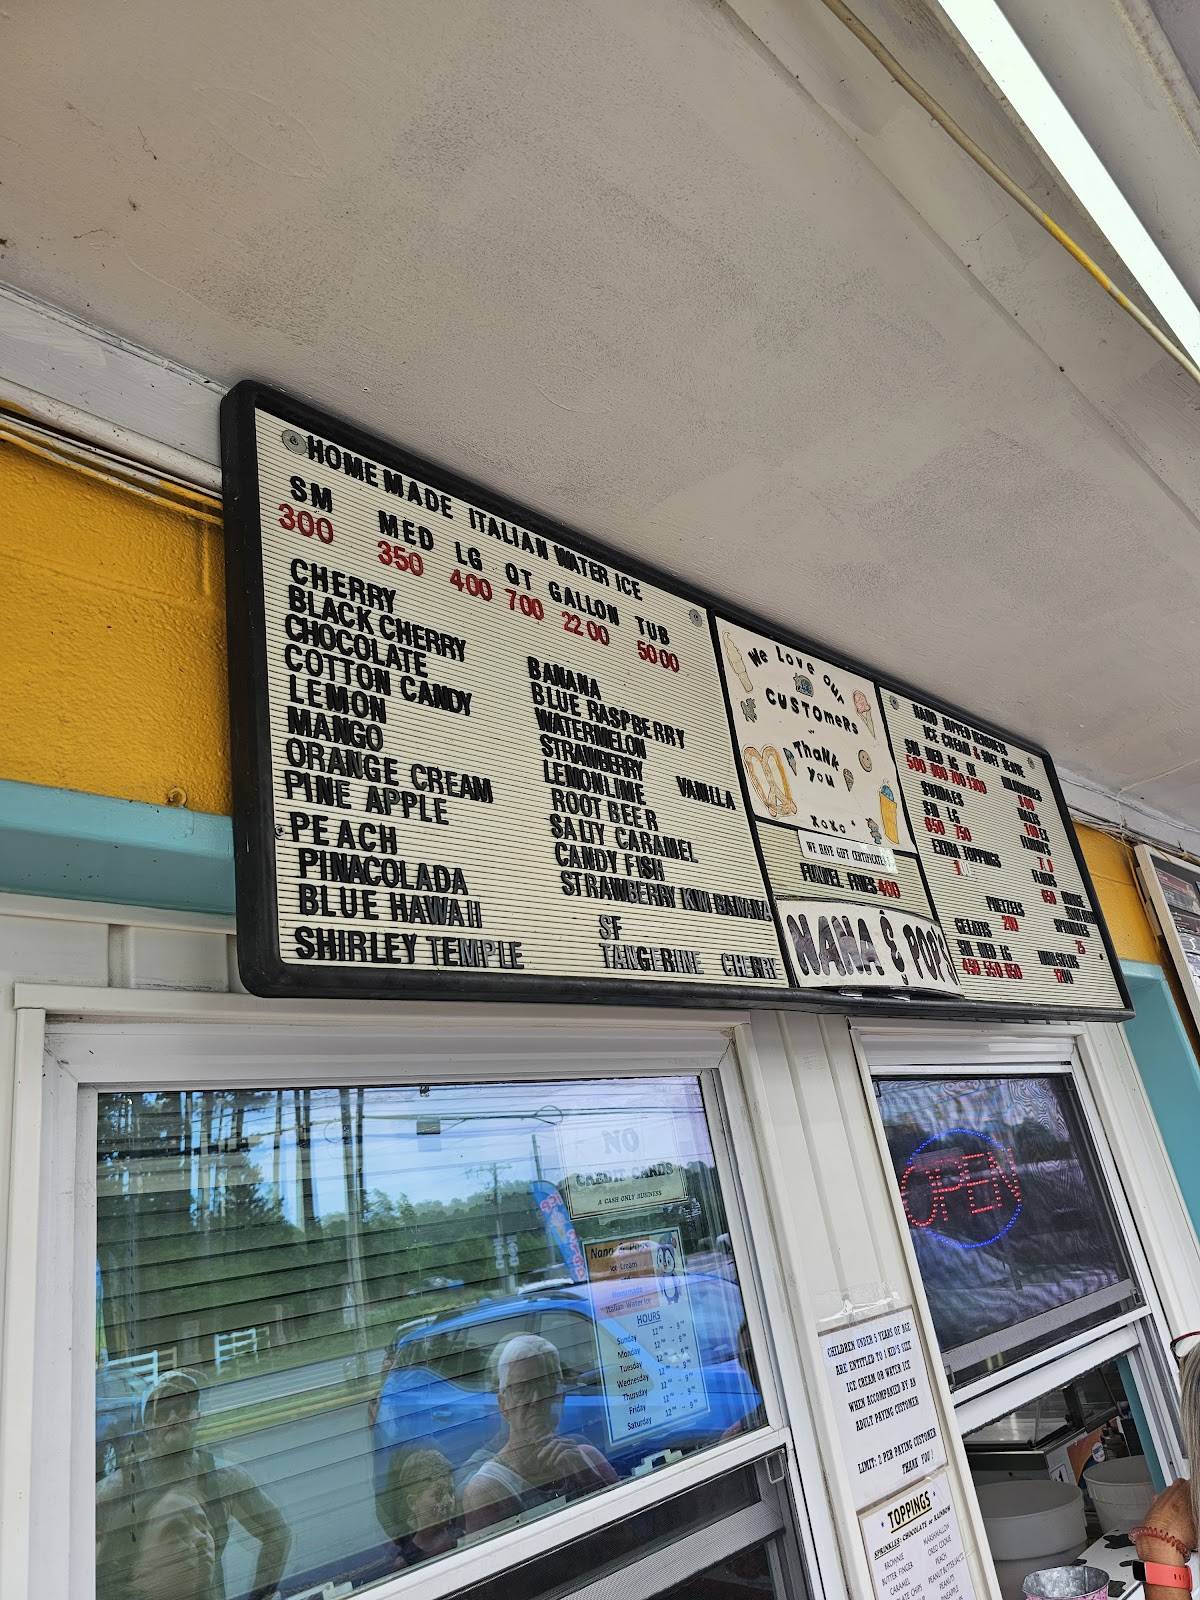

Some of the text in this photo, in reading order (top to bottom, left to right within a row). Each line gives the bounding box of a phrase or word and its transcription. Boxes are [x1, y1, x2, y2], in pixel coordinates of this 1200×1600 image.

[307, 436, 642, 601] HOME MADE ITALIAN WATER ICE
[290, 475, 669, 645] SM MED LG QT GALLON TUB
[278, 504, 333, 544] 300
[377, 541, 423, 576] 350
[450, 569, 492, 601] 400
[504, 588, 544, 621] 700
[637, 640, 679, 673] 5000
[290, 559, 396, 614] CHERRY
[288, 585, 466, 662] BLACK CHERRY
[285, 614, 428, 678] CHOCOLATE
[284, 644, 472, 717] COTTON CANDY
[528, 656, 600, 699] BANANA
[748, 648, 768, 667] We
[823, 674, 844, 704] our
[289, 674, 386, 724] LEMON
[531, 682, 684, 749] BLUE RASPBERRY
[287, 706, 383, 751] MANGO
[535, 707, 646, 759] WATERMELON
[923, 725, 939, 742] ICE
[942, 733, 971, 755] CREAM
[972, 746, 980, 759] &
[286, 738, 493, 804] ORANGE CREAM
[540, 735, 642, 781] STRAWBERRY
[904, 738, 921, 756] SM
[925, 747, 943, 764] MED
[948, 755, 959, 770] LG
[906, 754, 926, 772] 500
[284, 770, 449, 825] PINE APPLE
[551, 788, 658, 831] ROOT BEER
[676, 776, 736, 810] VANILLA
[921, 781, 963, 806] SUNDAES
[923, 800, 960, 823] SM LG
[290, 812, 397, 855] PEACH
[550, 814, 698, 863] SALTY CARAMEL
[806, 841, 816, 852] WE
[818, 844, 834, 857] HAVE
[932, 838, 960, 857] EXTRA
[554, 842, 665, 881] CANDY FISH
[299, 884, 482, 928] BLUE HAWAII
[560, 870, 773, 921] STRAWBERRY KIWI BANANA
[987, 897, 1024, 915] PRETZELS
[599, 914, 622, 940] SF
[787, 914, 884, 976] NANA
[295, 926, 524, 969] SHIRLEY TEMPLE
[599, 943, 777, 979] TANGERINE CHERRY
[957, 940, 1012, 960] SM MED LG
[621, 1194, 635, 1203] ONLY
[637, 1311, 661, 1325] HOURS
[617, 1335, 637, 1345] Sunday
[618, 1348, 640, 1359] Monday
[827, 1341, 855, 1357] CHILDREN
[856, 1335, 872, 1348] UNDER
[879, 1328, 893, 1340] YEARS
[617, 1374, 649, 1388] Wednesday
[620, 1362, 642, 1373] Tuesday
[836, 1363, 847, 1375] ARE
[849, 1354, 874, 1370] ENTITLED
[875, 1351, 882, 1361] TO
[846, 1360, 910, 1392] ICE CREAM OR WATER ICE
[623, 1388, 648, 1401] Thursday
[629, 1404, 646, 1415] Friday
[849, 1377, 916, 1412] WHEN BY AN
[628, 1416, 651, 1430] Saturday
[855, 1397, 919, 1430] ADULT PAYING CUSTOMER
[878, 1455, 881, 1464] 2
[883, 1450, 893, 1462] PER
[894, 1440, 912, 1456] PAYING
[913, 1428, 936, 1446] CUSTOMER
[902, 1458, 918, 1473] THANK
[887, 1491, 931, 1528] TOPPINGS
